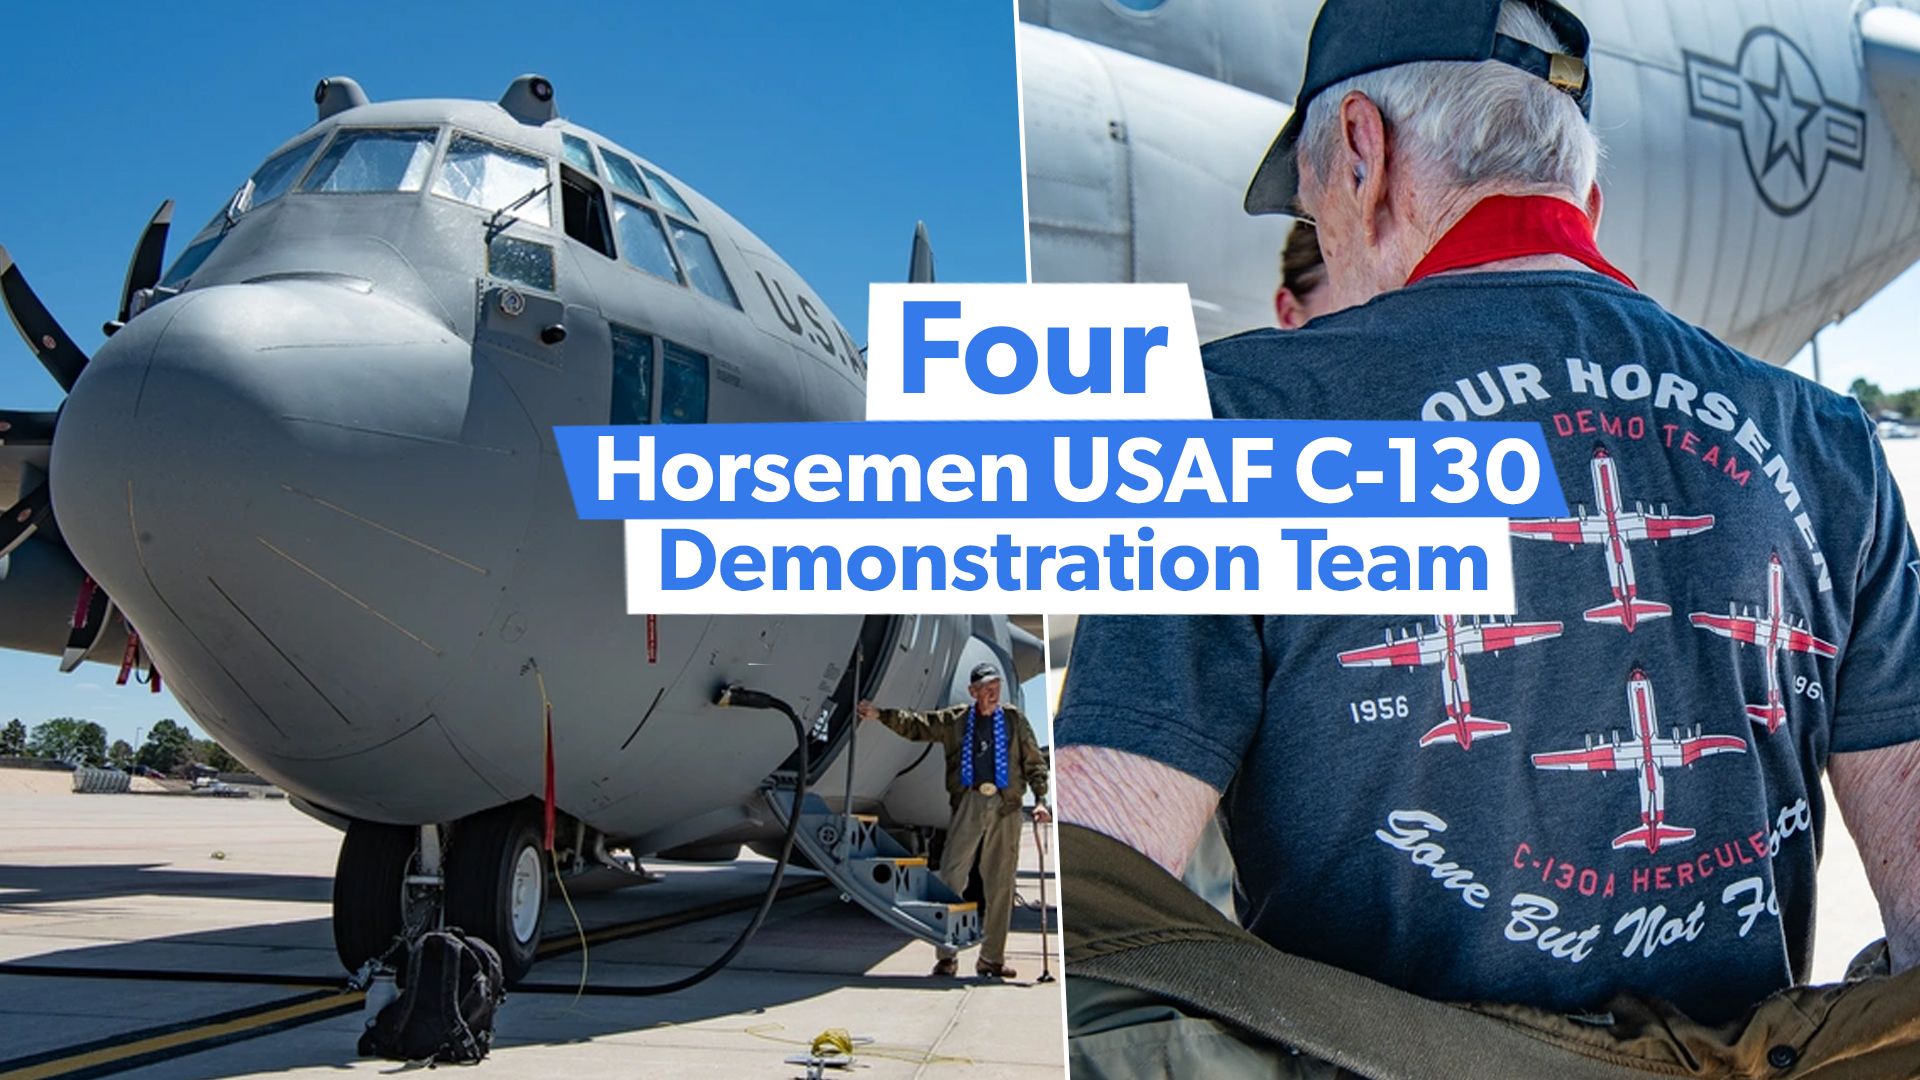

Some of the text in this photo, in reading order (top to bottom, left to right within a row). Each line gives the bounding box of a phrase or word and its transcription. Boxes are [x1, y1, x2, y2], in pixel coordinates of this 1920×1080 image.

[1421, 358, 1832, 592] OUR HORSEMEN
[1553, 409, 1751, 487] DEMO TEAM
[1350, 695, 1409, 724] 1956
[1375, 809, 1490, 909] Gone
[1504, 893, 1600, 963] But
[1613, 901, 1705, 960] Not
[1513, 820, 1770, 898] C-130A HERCULE
